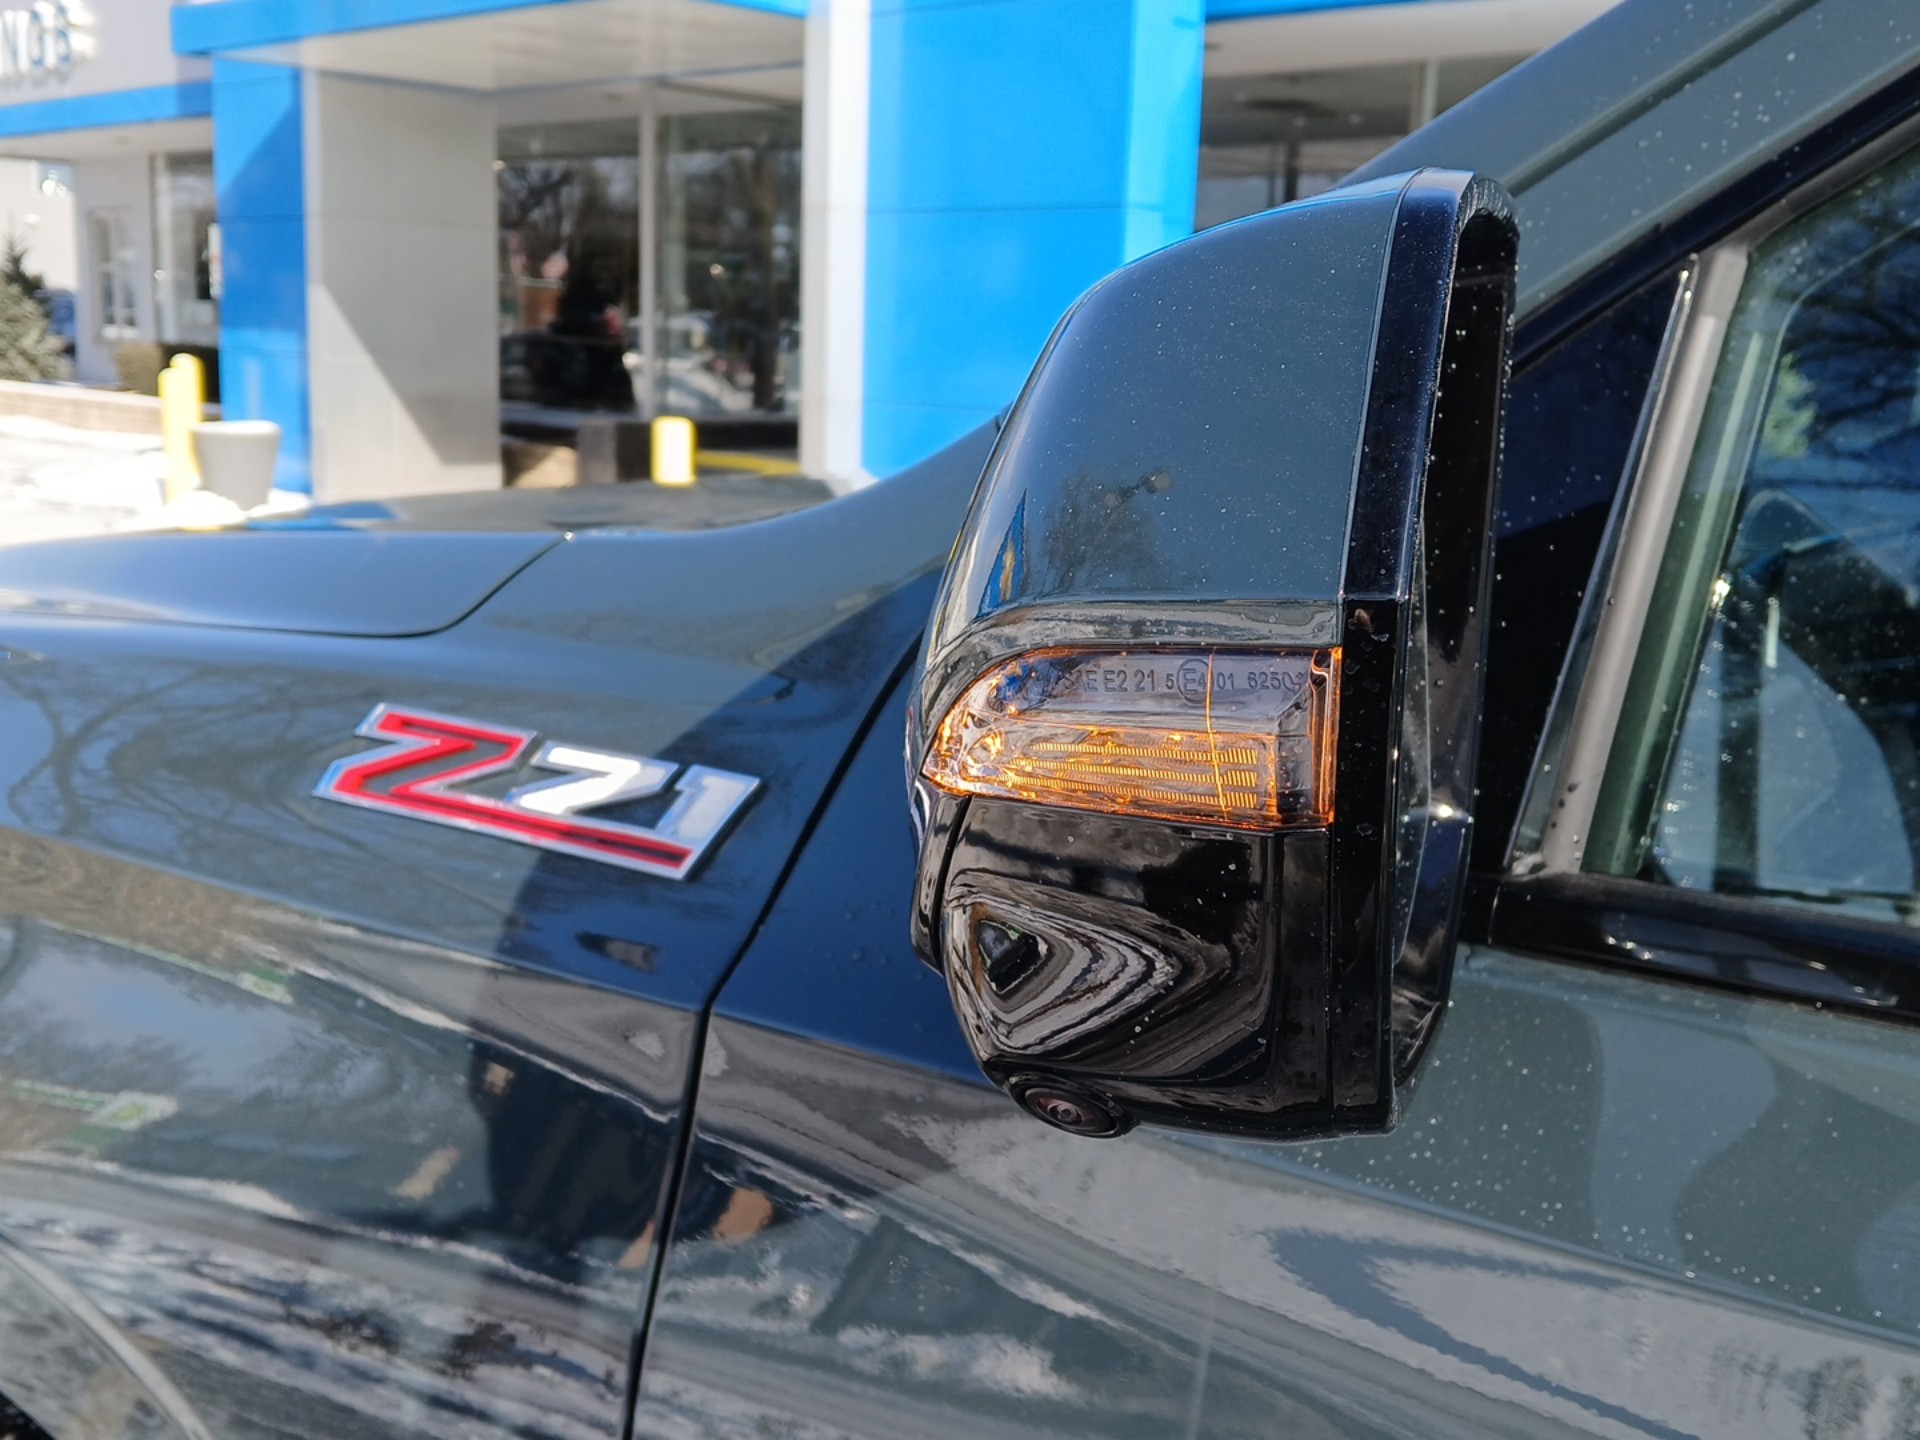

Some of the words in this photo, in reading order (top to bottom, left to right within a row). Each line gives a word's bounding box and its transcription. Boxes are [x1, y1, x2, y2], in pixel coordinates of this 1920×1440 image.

[1103, 669, 1128, 693] E2
[1134, 669, 1156, 693] 21
[1165, 672, 1175, 690] 5
[1216, 671, 1234, 690] 01
[312, 702, 762, 881] Z71
